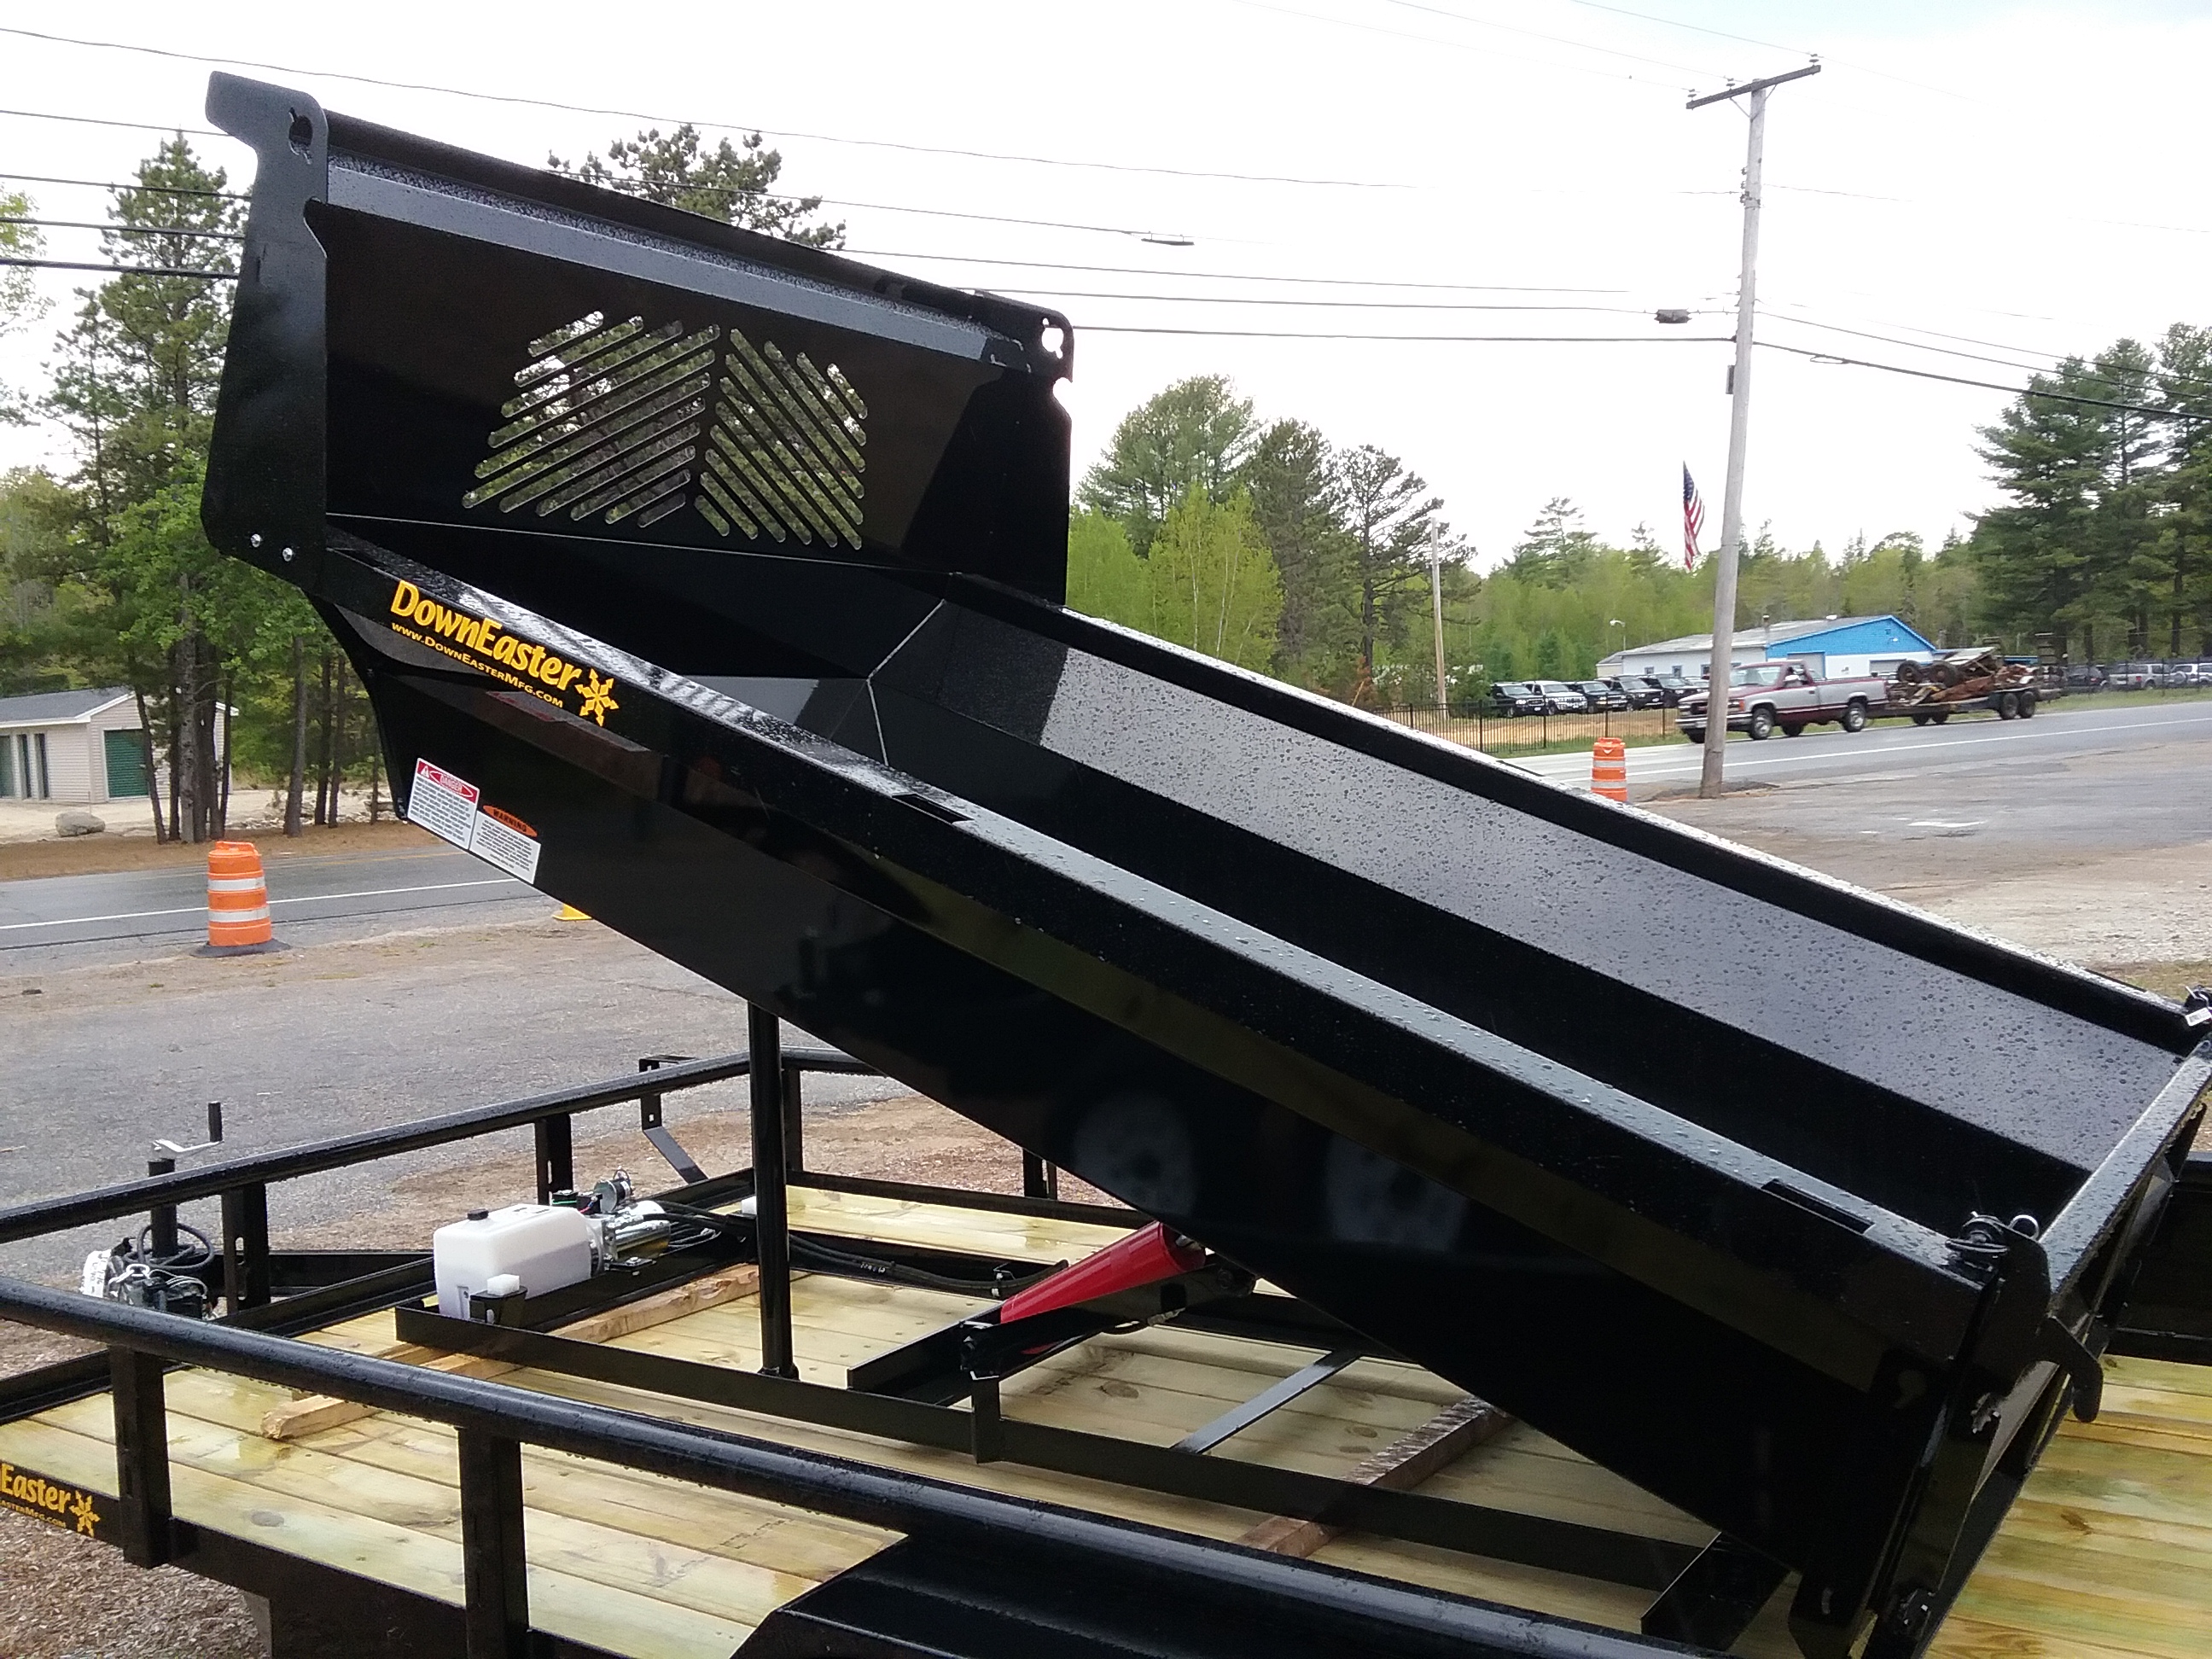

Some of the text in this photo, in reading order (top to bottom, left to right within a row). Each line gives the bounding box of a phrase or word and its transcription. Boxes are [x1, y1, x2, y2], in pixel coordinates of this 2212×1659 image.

[390, 579, 581, 692] DownEaster
[493, 809, 527, 833] WARNING
[0, 1463, 72, 1514] Easter
